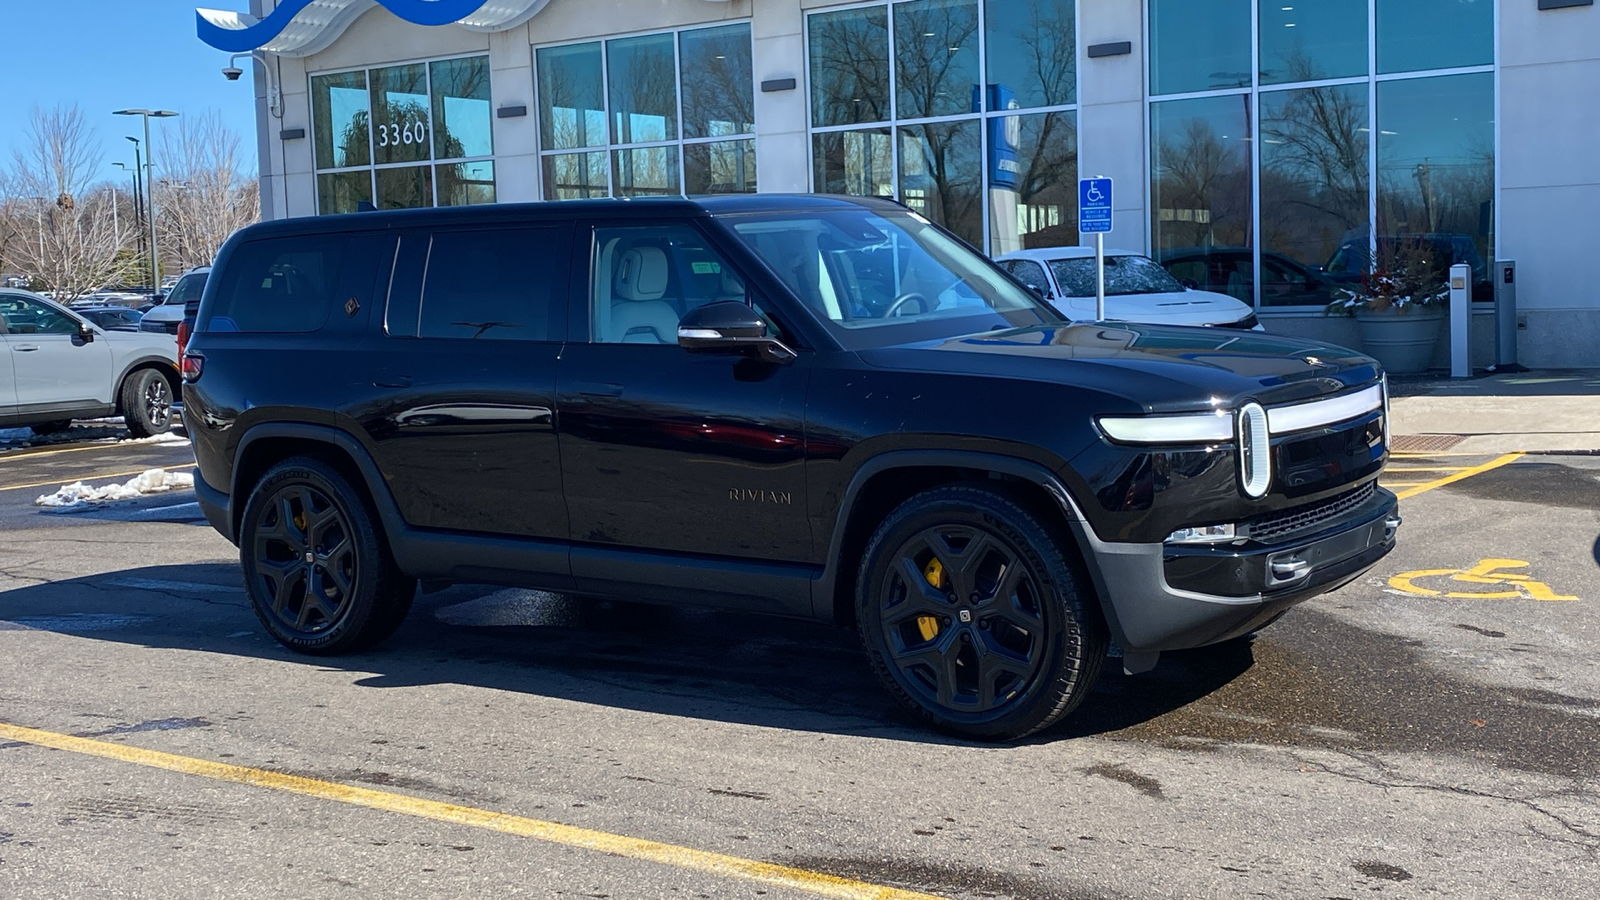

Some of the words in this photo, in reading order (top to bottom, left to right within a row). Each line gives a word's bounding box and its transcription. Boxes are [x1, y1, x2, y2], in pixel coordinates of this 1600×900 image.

[379, 121, 425, 147] 3360
[271, 471, 309, 485] MICHELIN
[729, 487, 791, 504] RIVIAN
